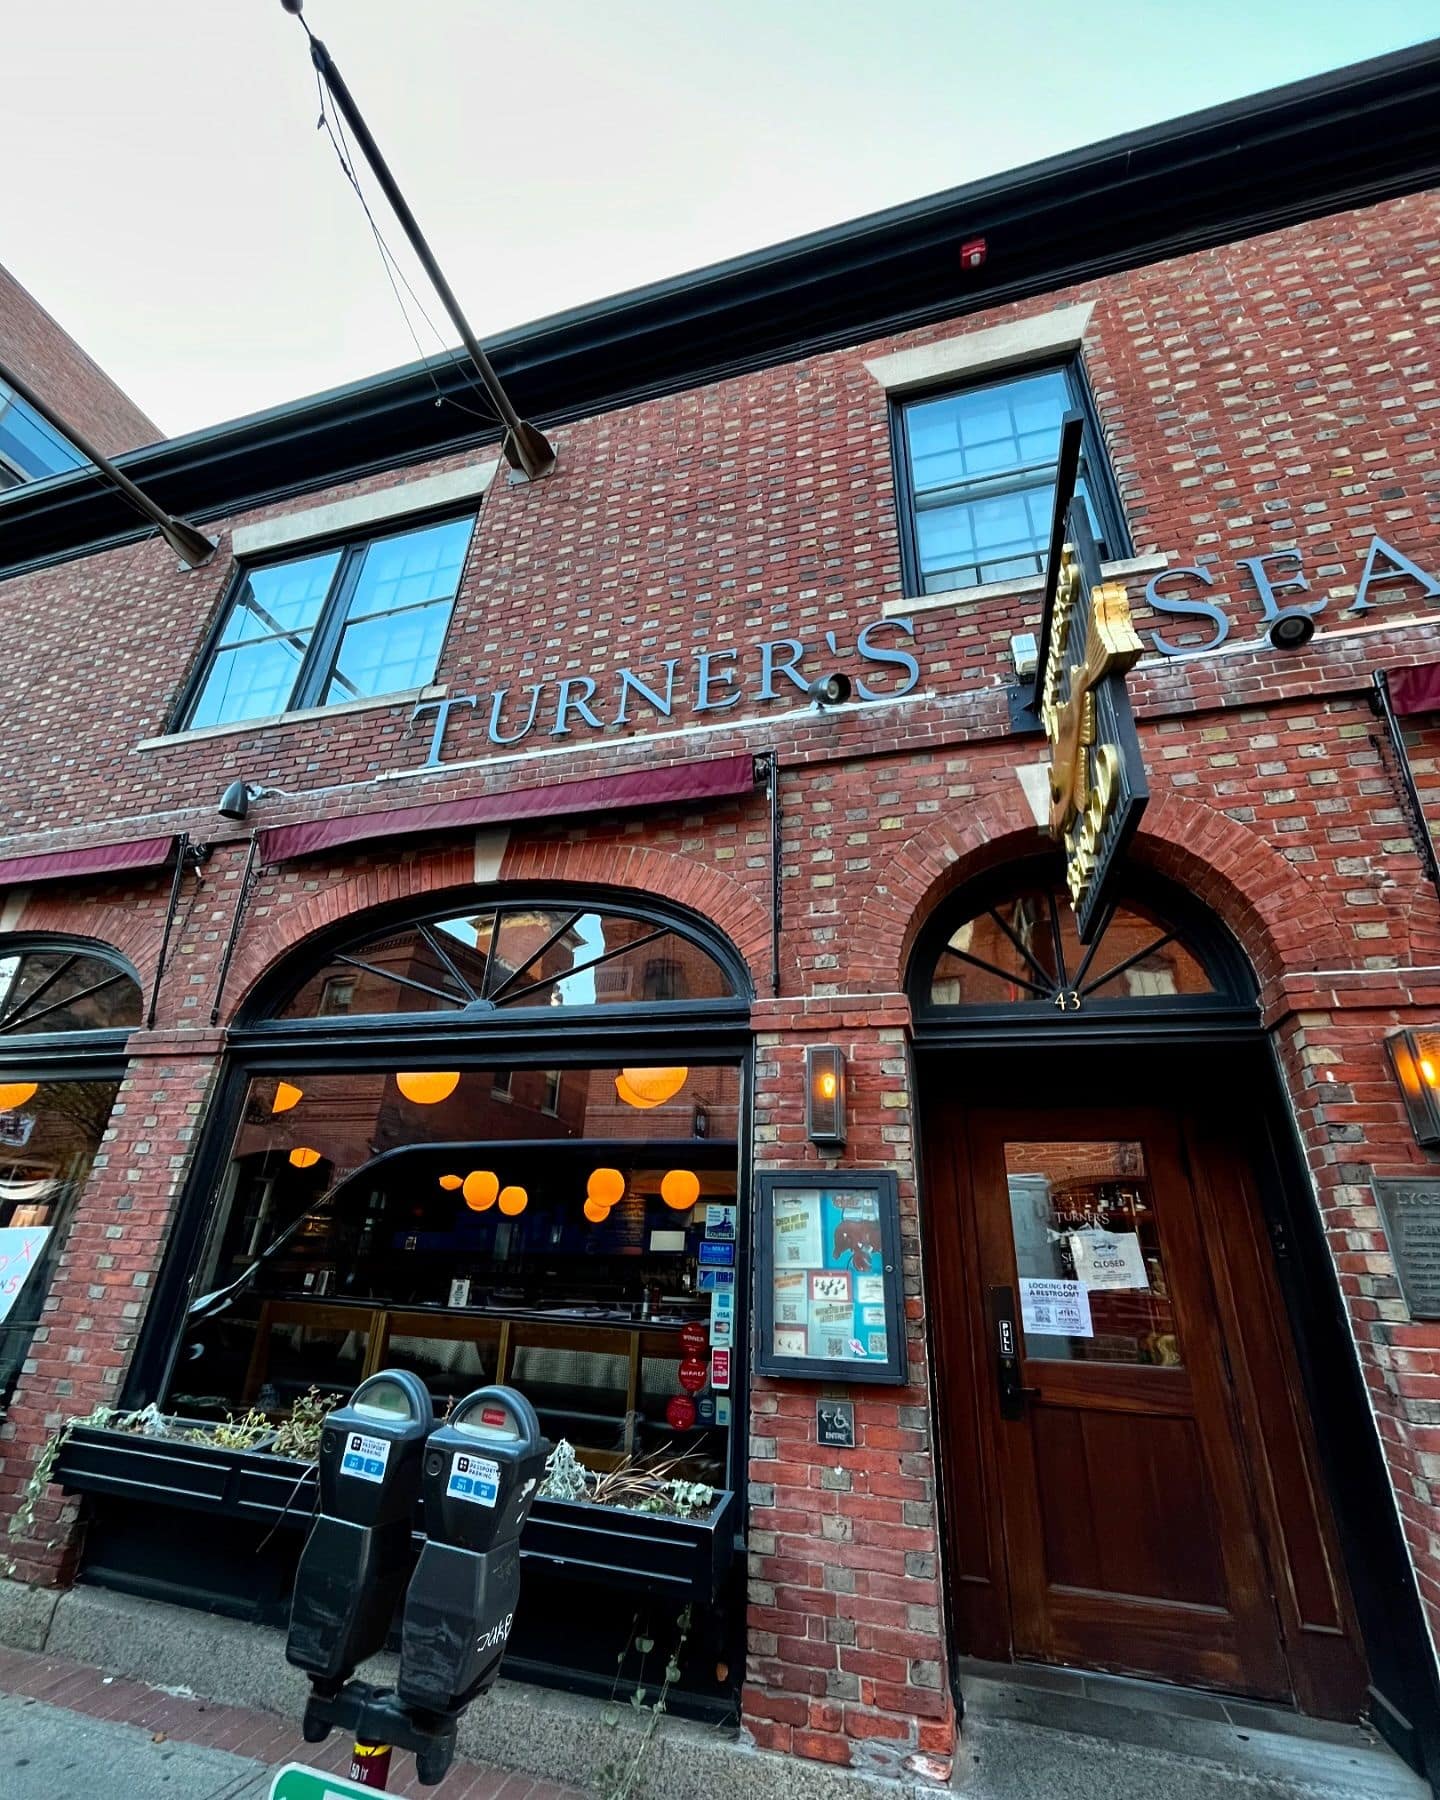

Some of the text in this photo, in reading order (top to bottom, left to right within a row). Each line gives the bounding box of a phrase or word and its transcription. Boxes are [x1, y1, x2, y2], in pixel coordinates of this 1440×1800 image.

[413, 618, 921, 768] TURNER'S
[1055, 991, 1081, 1011] 43
[1093, 1260, 1125, 1268] CLOSED
[1002, 1322, 1010, 1351] PULL
